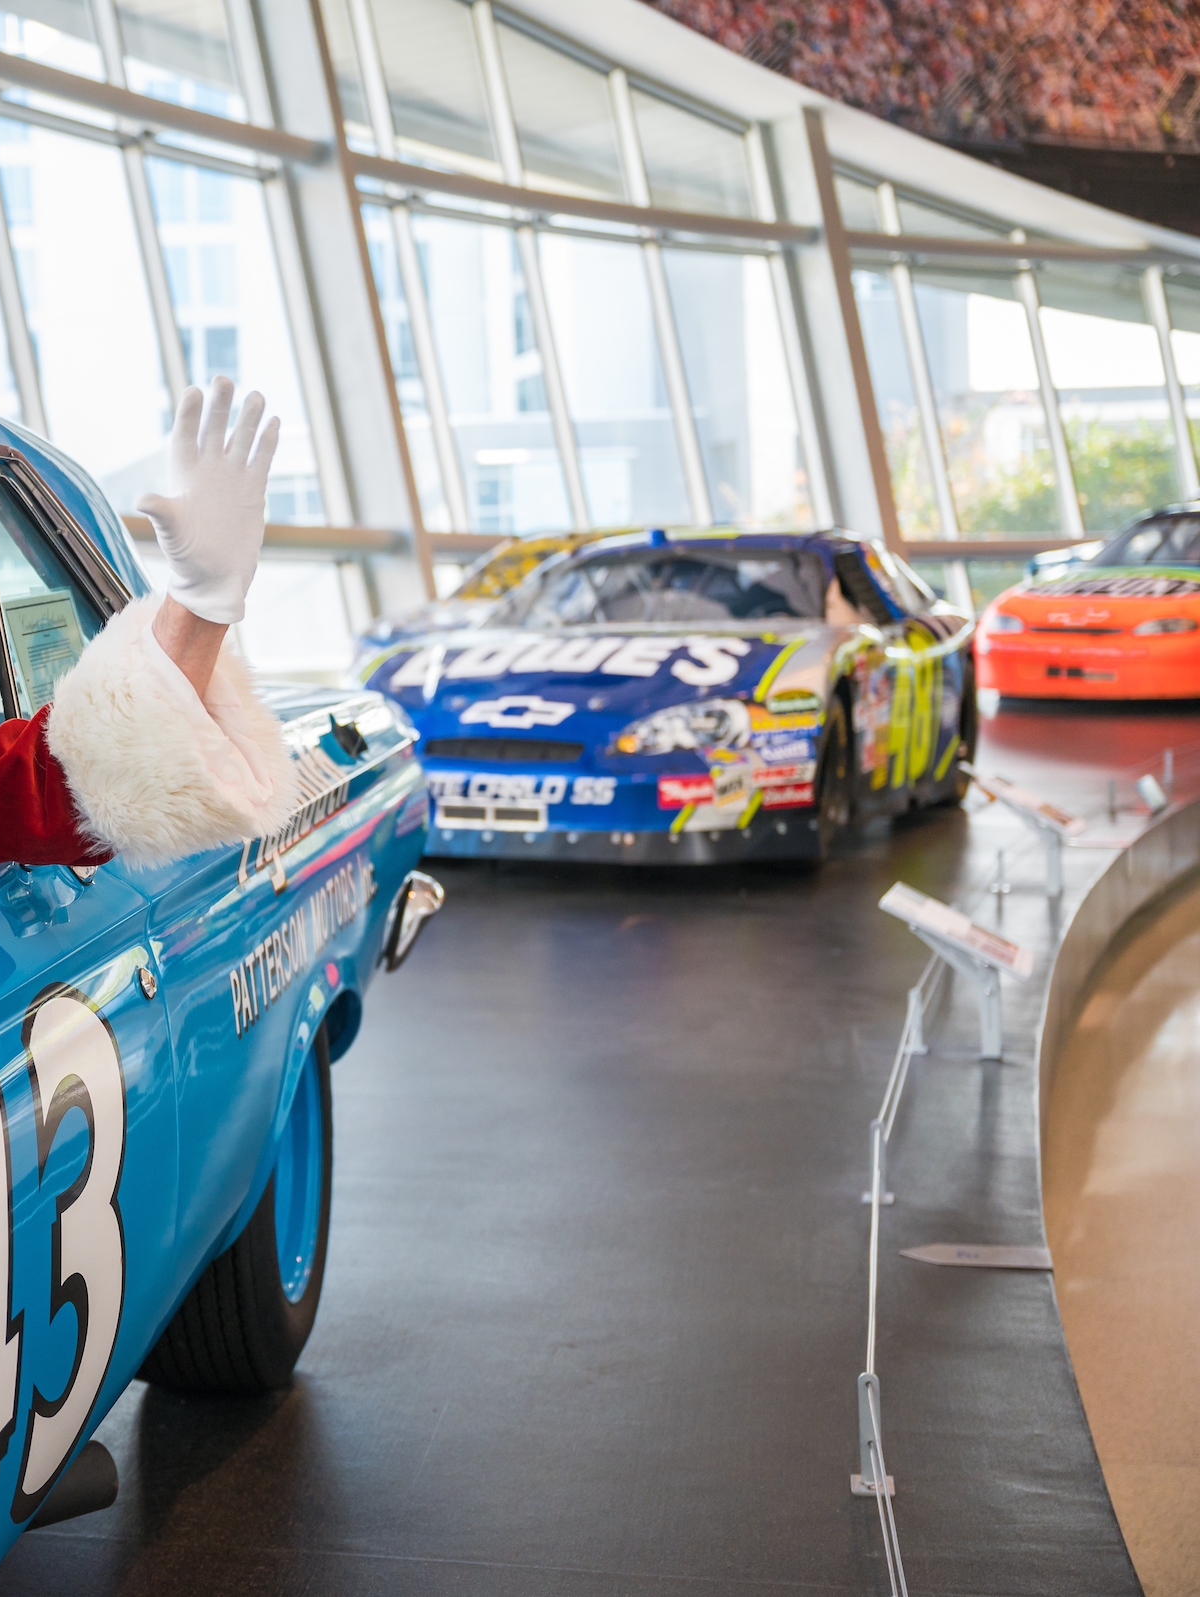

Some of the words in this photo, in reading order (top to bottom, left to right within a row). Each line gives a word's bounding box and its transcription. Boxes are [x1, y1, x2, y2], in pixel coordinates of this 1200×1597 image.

[390, 634, 752, 687] LOWE'S
[469, 774, 568, 804] CARLO
[570, 777, 618, 806] SS
[230, 906, 309, 1040] PATTERSON
[310, 862, 358, 957] MOTORS
